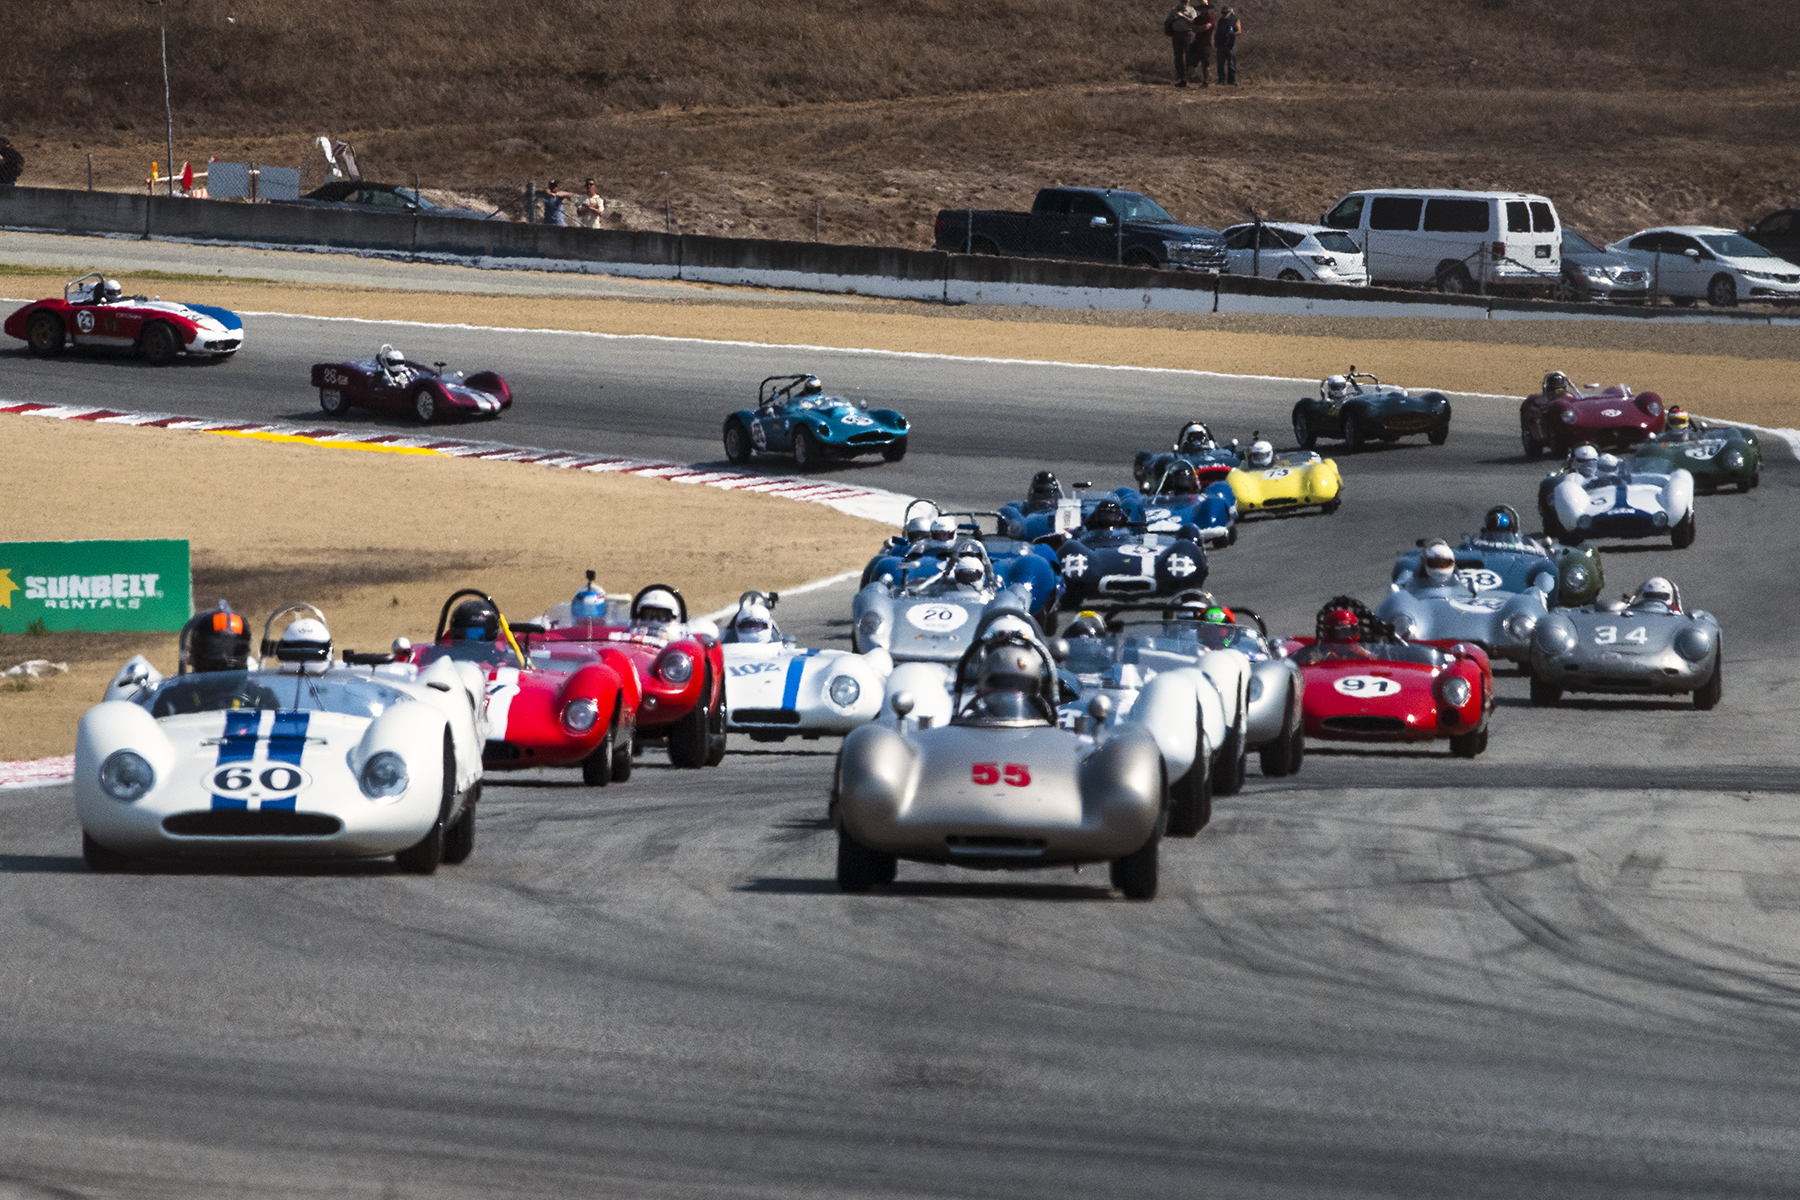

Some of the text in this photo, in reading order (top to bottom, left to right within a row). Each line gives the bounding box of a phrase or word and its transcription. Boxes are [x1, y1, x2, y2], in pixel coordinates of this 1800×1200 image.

[25, 573, 160, 599] SUNBELT
[44, 599, 140, 610] RENTALS
[923, 609, 953, 621] 20
[1594, 626, 1648, 645] 34
[729, 662, 781, 677] 102
[1342, 679, 1388, 692] 91
[213, 760, 302, 791] 60
[972, 762, 1032, 788] 55
